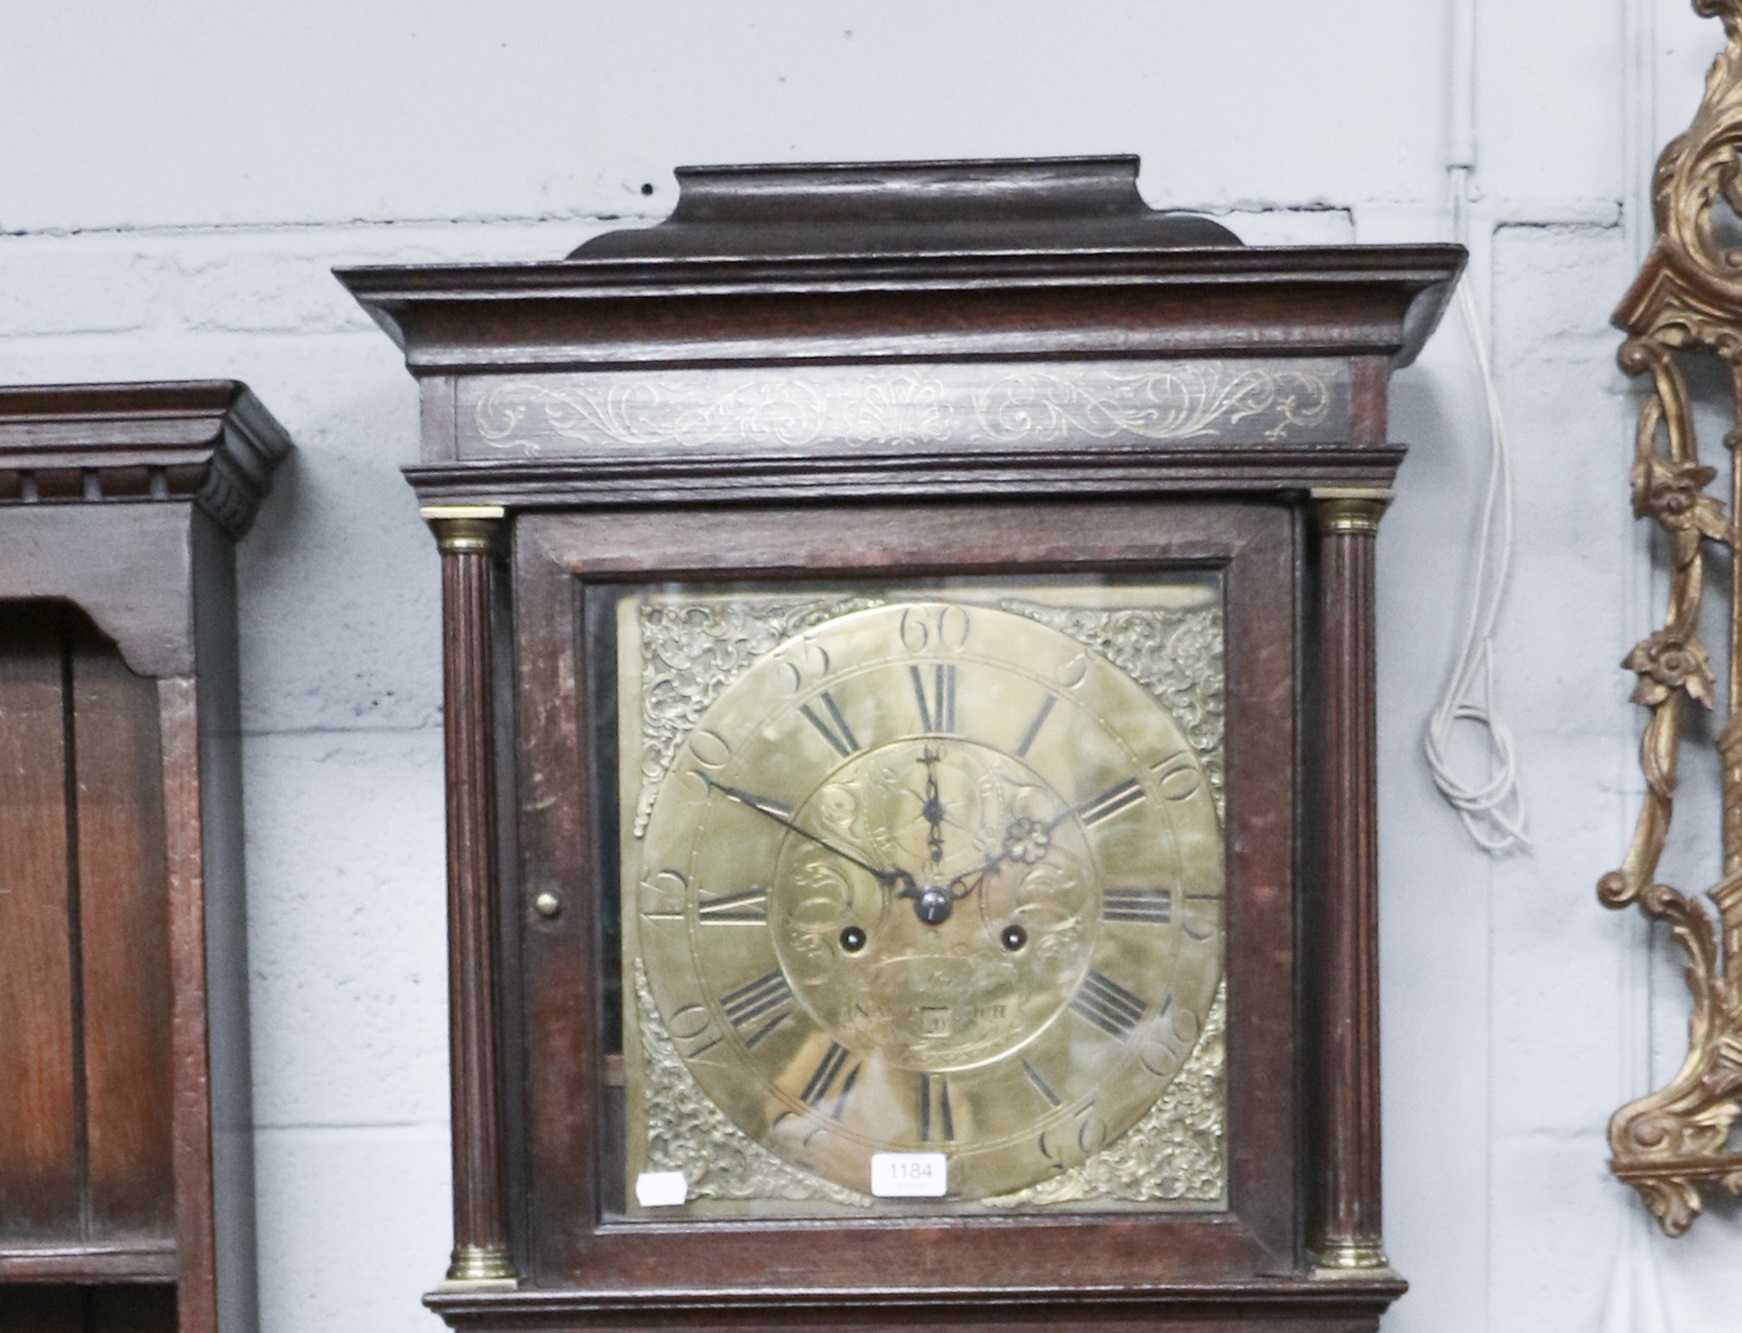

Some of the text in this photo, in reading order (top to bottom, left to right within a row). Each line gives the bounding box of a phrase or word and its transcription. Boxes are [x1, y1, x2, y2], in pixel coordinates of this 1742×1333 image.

[899, 602, 970, 652] 60
[1148, 749, 1200, 801] 10
[1101, 887, 1172, 924] III
[890, 1162, 932, 1179] 1184
